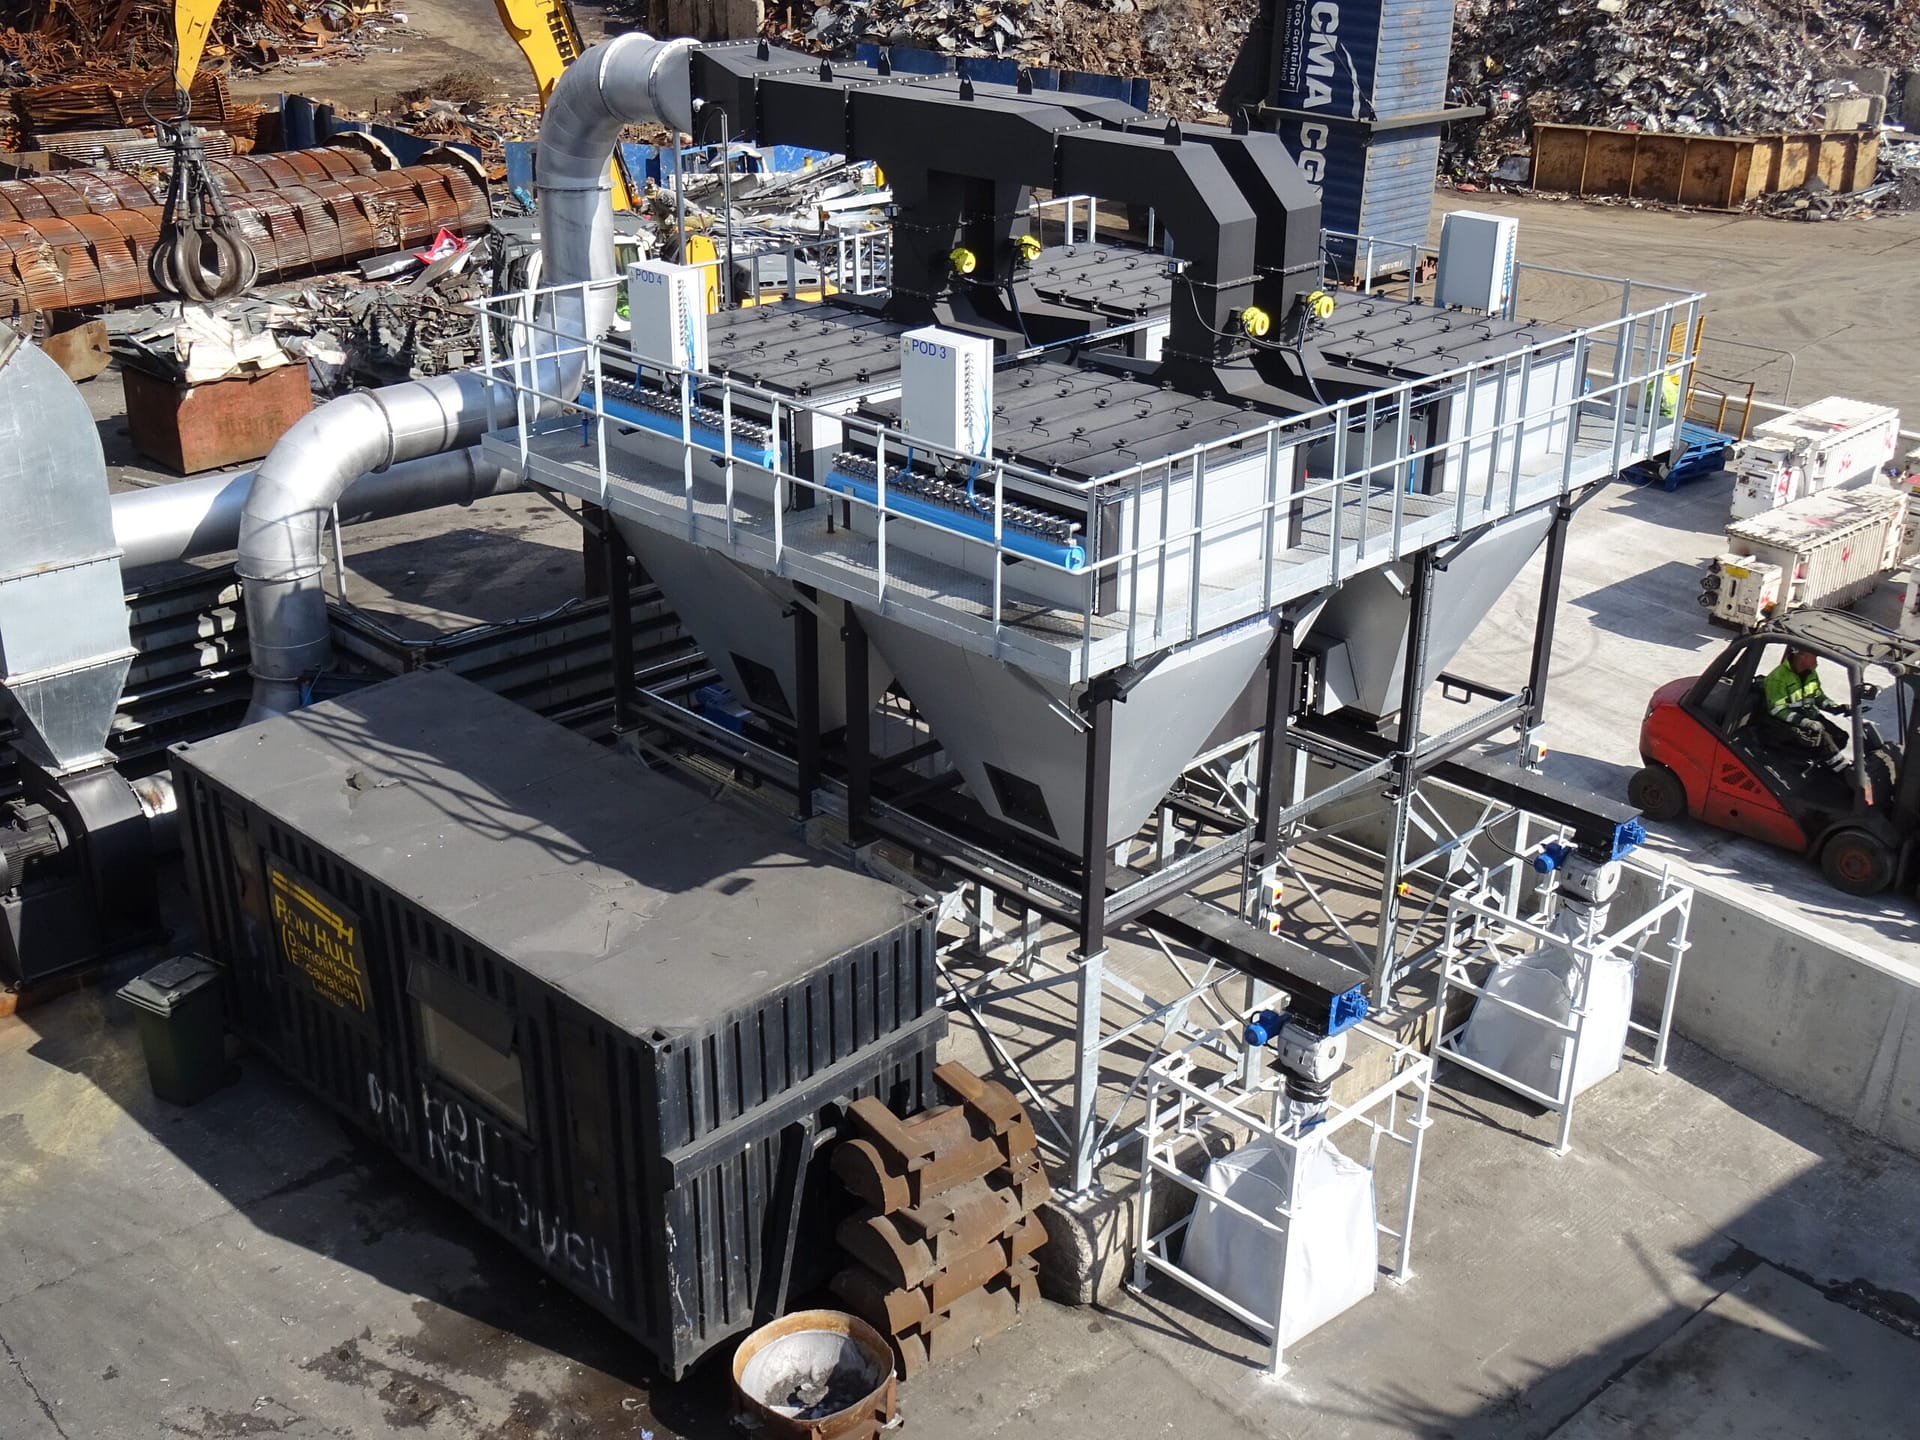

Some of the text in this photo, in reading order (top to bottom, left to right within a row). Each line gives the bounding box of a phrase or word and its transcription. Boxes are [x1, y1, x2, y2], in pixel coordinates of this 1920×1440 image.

[1289, 30, 1300, 88] container
[1303, 1, 1339, 108] CMA
[635, 268, 662, 285] POD 4
[912, 339, 947, 359] POD 3
[287, 930, 354, 987] Demolition
